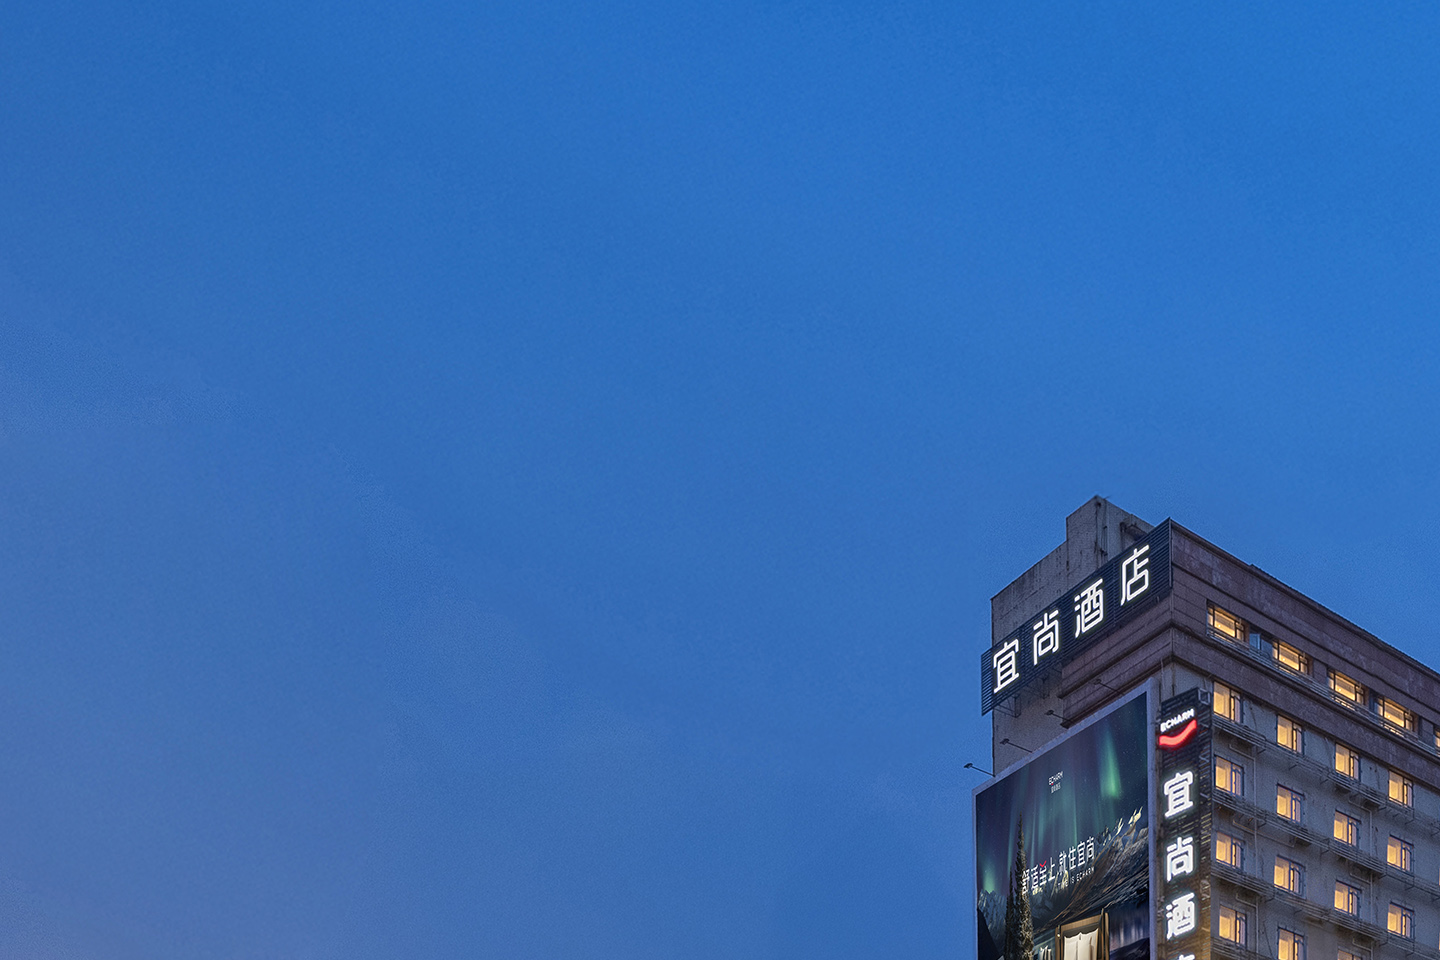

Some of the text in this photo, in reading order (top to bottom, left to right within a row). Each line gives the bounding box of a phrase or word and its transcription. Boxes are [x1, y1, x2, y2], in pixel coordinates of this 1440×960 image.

[993, 544, 1150, 694] 宜尚酒店
[1160, 708, 1195, 733] ECHARM
